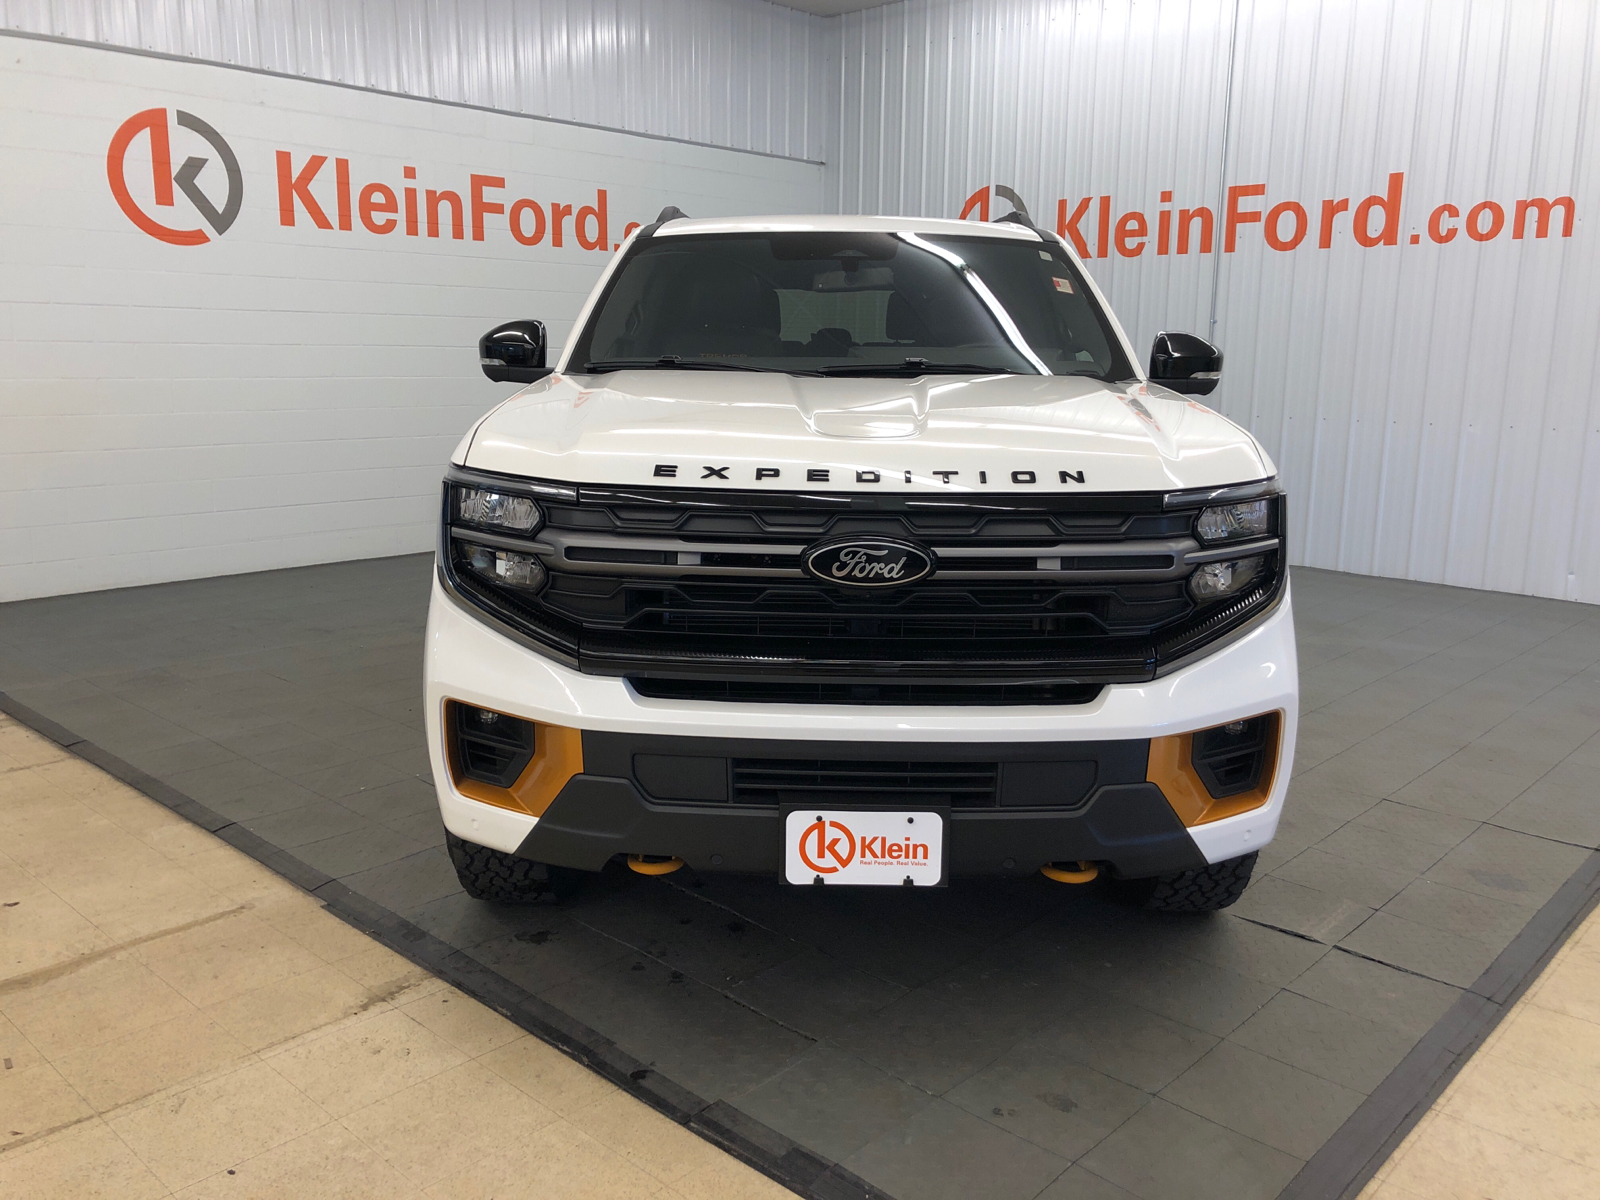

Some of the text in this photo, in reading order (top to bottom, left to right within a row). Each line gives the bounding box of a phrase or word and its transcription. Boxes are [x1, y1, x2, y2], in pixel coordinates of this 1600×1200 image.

[275, 149, 641, 253] KleinFord.
[1056, 172, 1575, 260] KleinFord.com
[653, 465, 1085, 484] EXPEDITION
[831, 548, 904, 579] Ford
[860, 836, 929, 860] Klein
